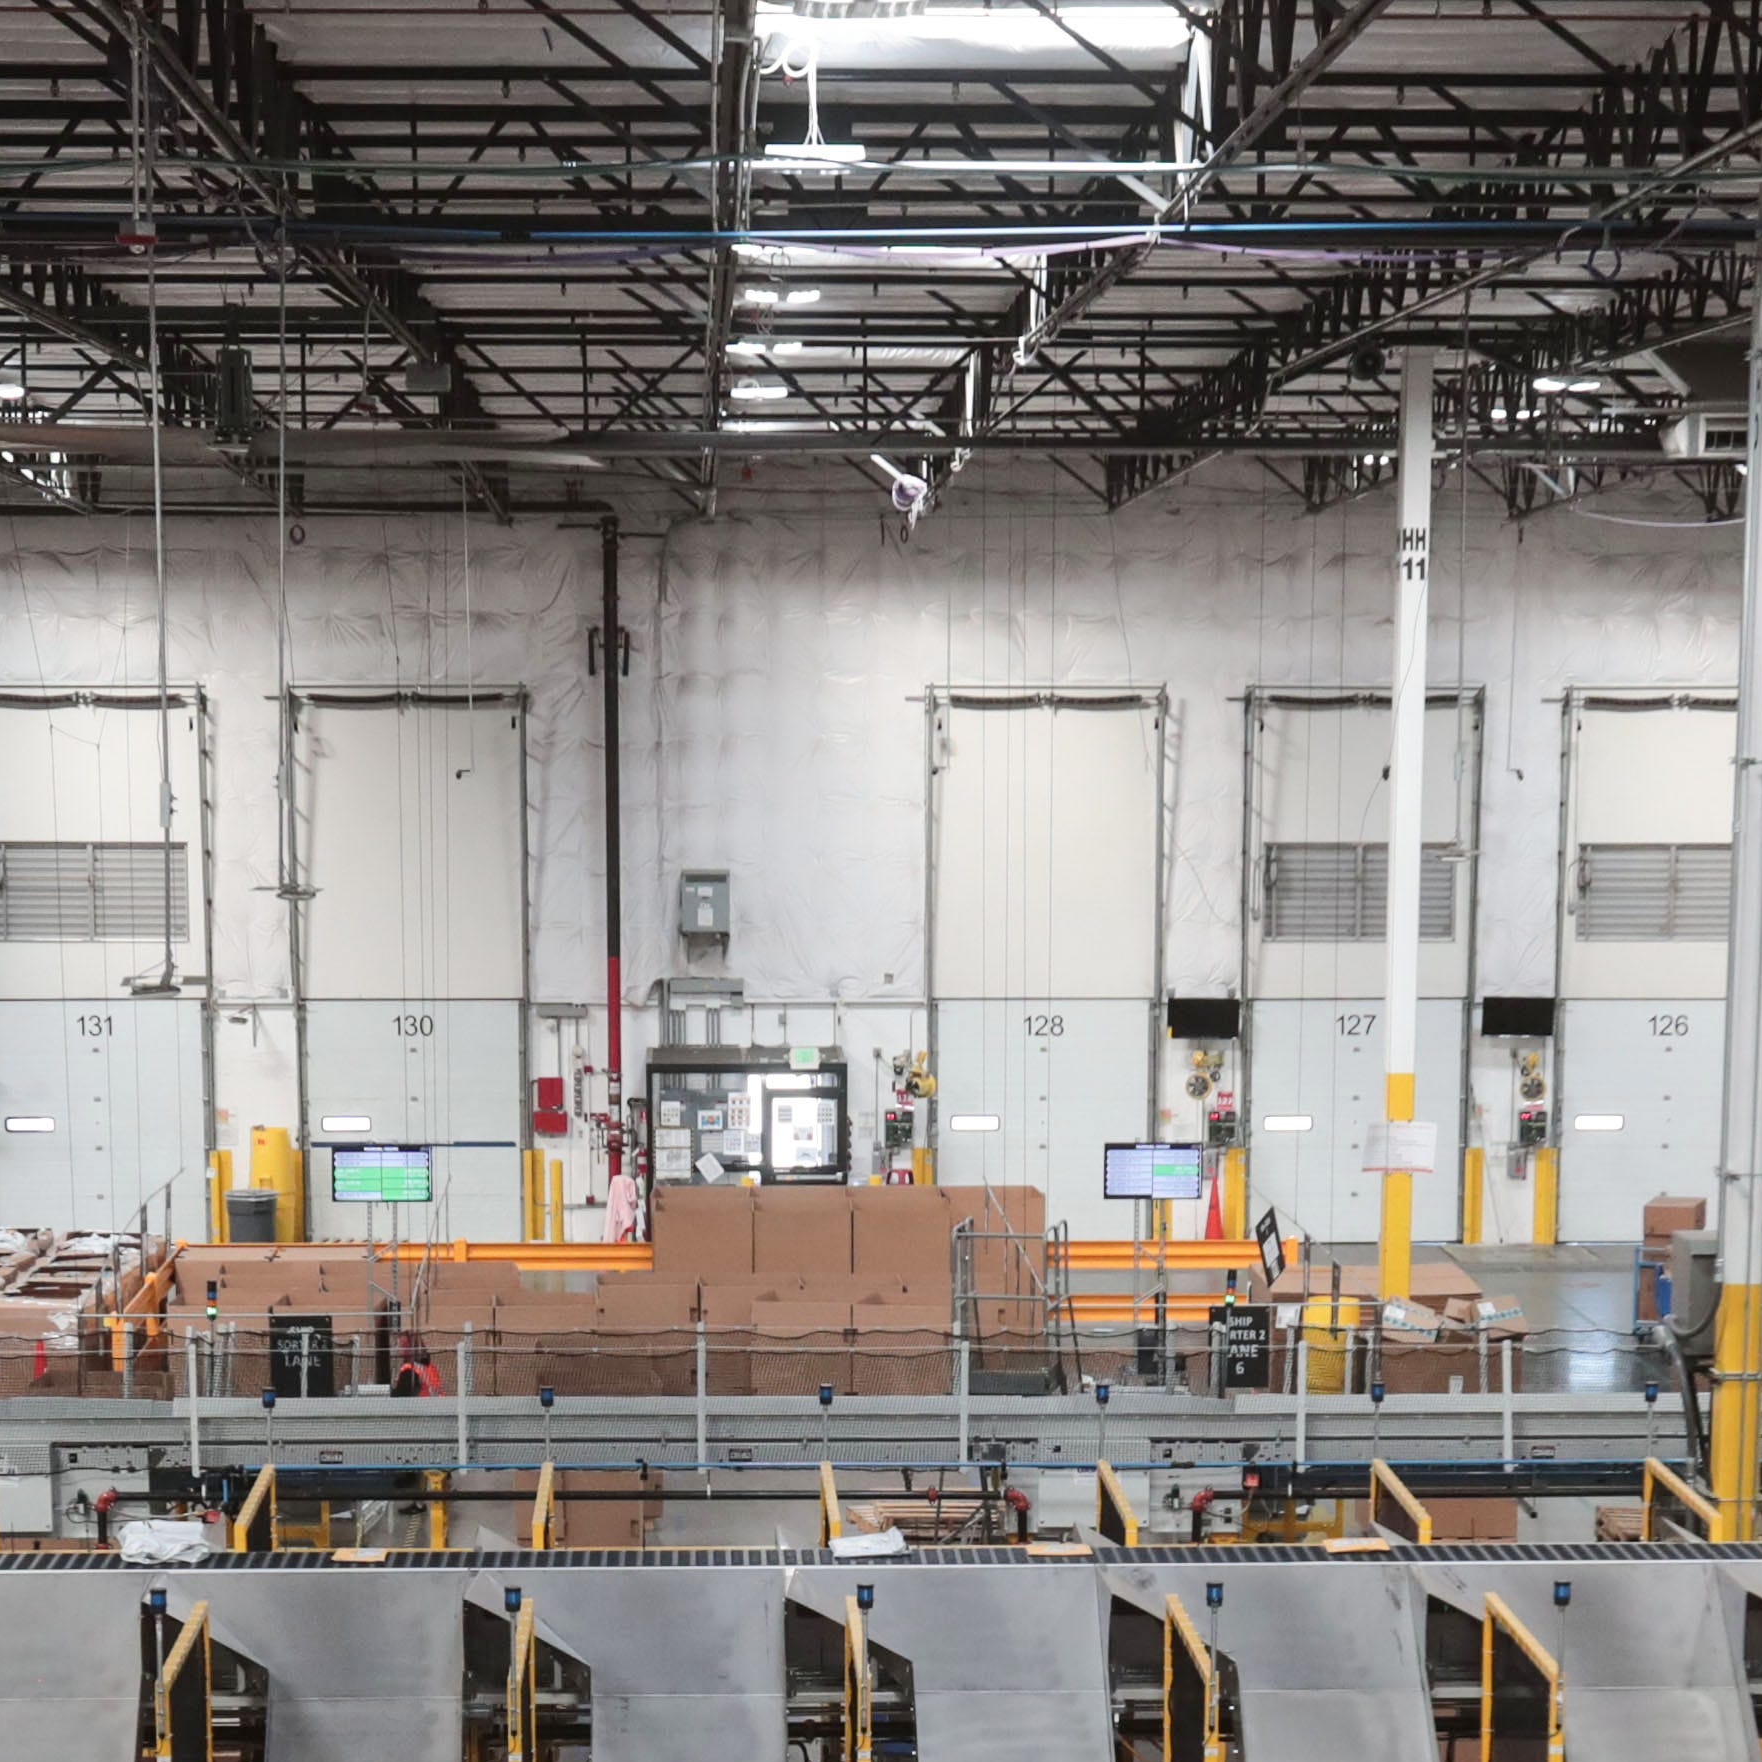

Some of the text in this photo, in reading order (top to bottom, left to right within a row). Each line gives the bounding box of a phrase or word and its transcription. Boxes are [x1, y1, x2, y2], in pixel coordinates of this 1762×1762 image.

[1402, 528, 1426, 551] HH
[1402, 558, 1426, 581] 11
[76, 1016, 114, 1037] 131
[392, 1015, 434, 1038] 130
[1023, 1015, 1064, 1037] 128
[1335, 1015, 1376, 1037] 127
[1647, 1015, 1689, 1037] 126
[1230, 1316, 1253, 1327] SHIP
[1259, 1330, 1266, 1340] 2
[1228, 1345, 1259, 1357] ANE
[1236, 1362, 1245, 1375] 6
